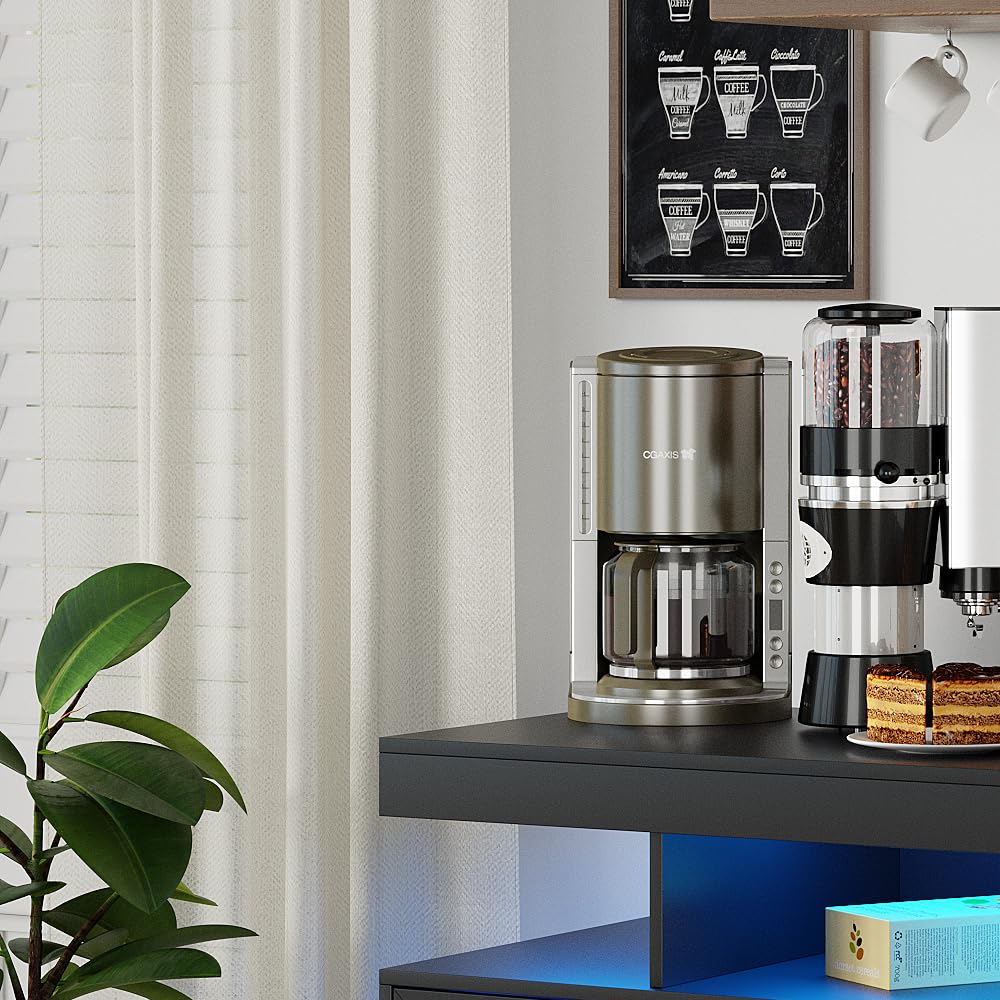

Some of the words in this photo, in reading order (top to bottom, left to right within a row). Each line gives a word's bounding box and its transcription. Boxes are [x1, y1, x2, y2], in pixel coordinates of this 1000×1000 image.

[658, 49, 685, 62] Caramel
[770, 47, 801, 61] Cioccolato
[670, 84, 691, 103] Milk
[724, 82, 750, 94] COFFEE
[670, 105, 691, 115] COFFEE
[728, 101, 746, 117] Milk
[780, 101, 806, 109] CHOCOLATE
[783, 116, 803, 125] COFFEE
[658, 167, 689, 180] Americano
[713, 167, 738, 179] Corretto
[770, 166, 787, 179] Corto
[668, 205, 693, 216] COFFEE
[723, 218, 750, 228] WHISKEY
[670, 232, 690, 241] WATER
[727, 234, 747, 244] COFFEE
[784, 239, 802, 247] COFFEE
[642, 450, 680, 460] CGAXIS
